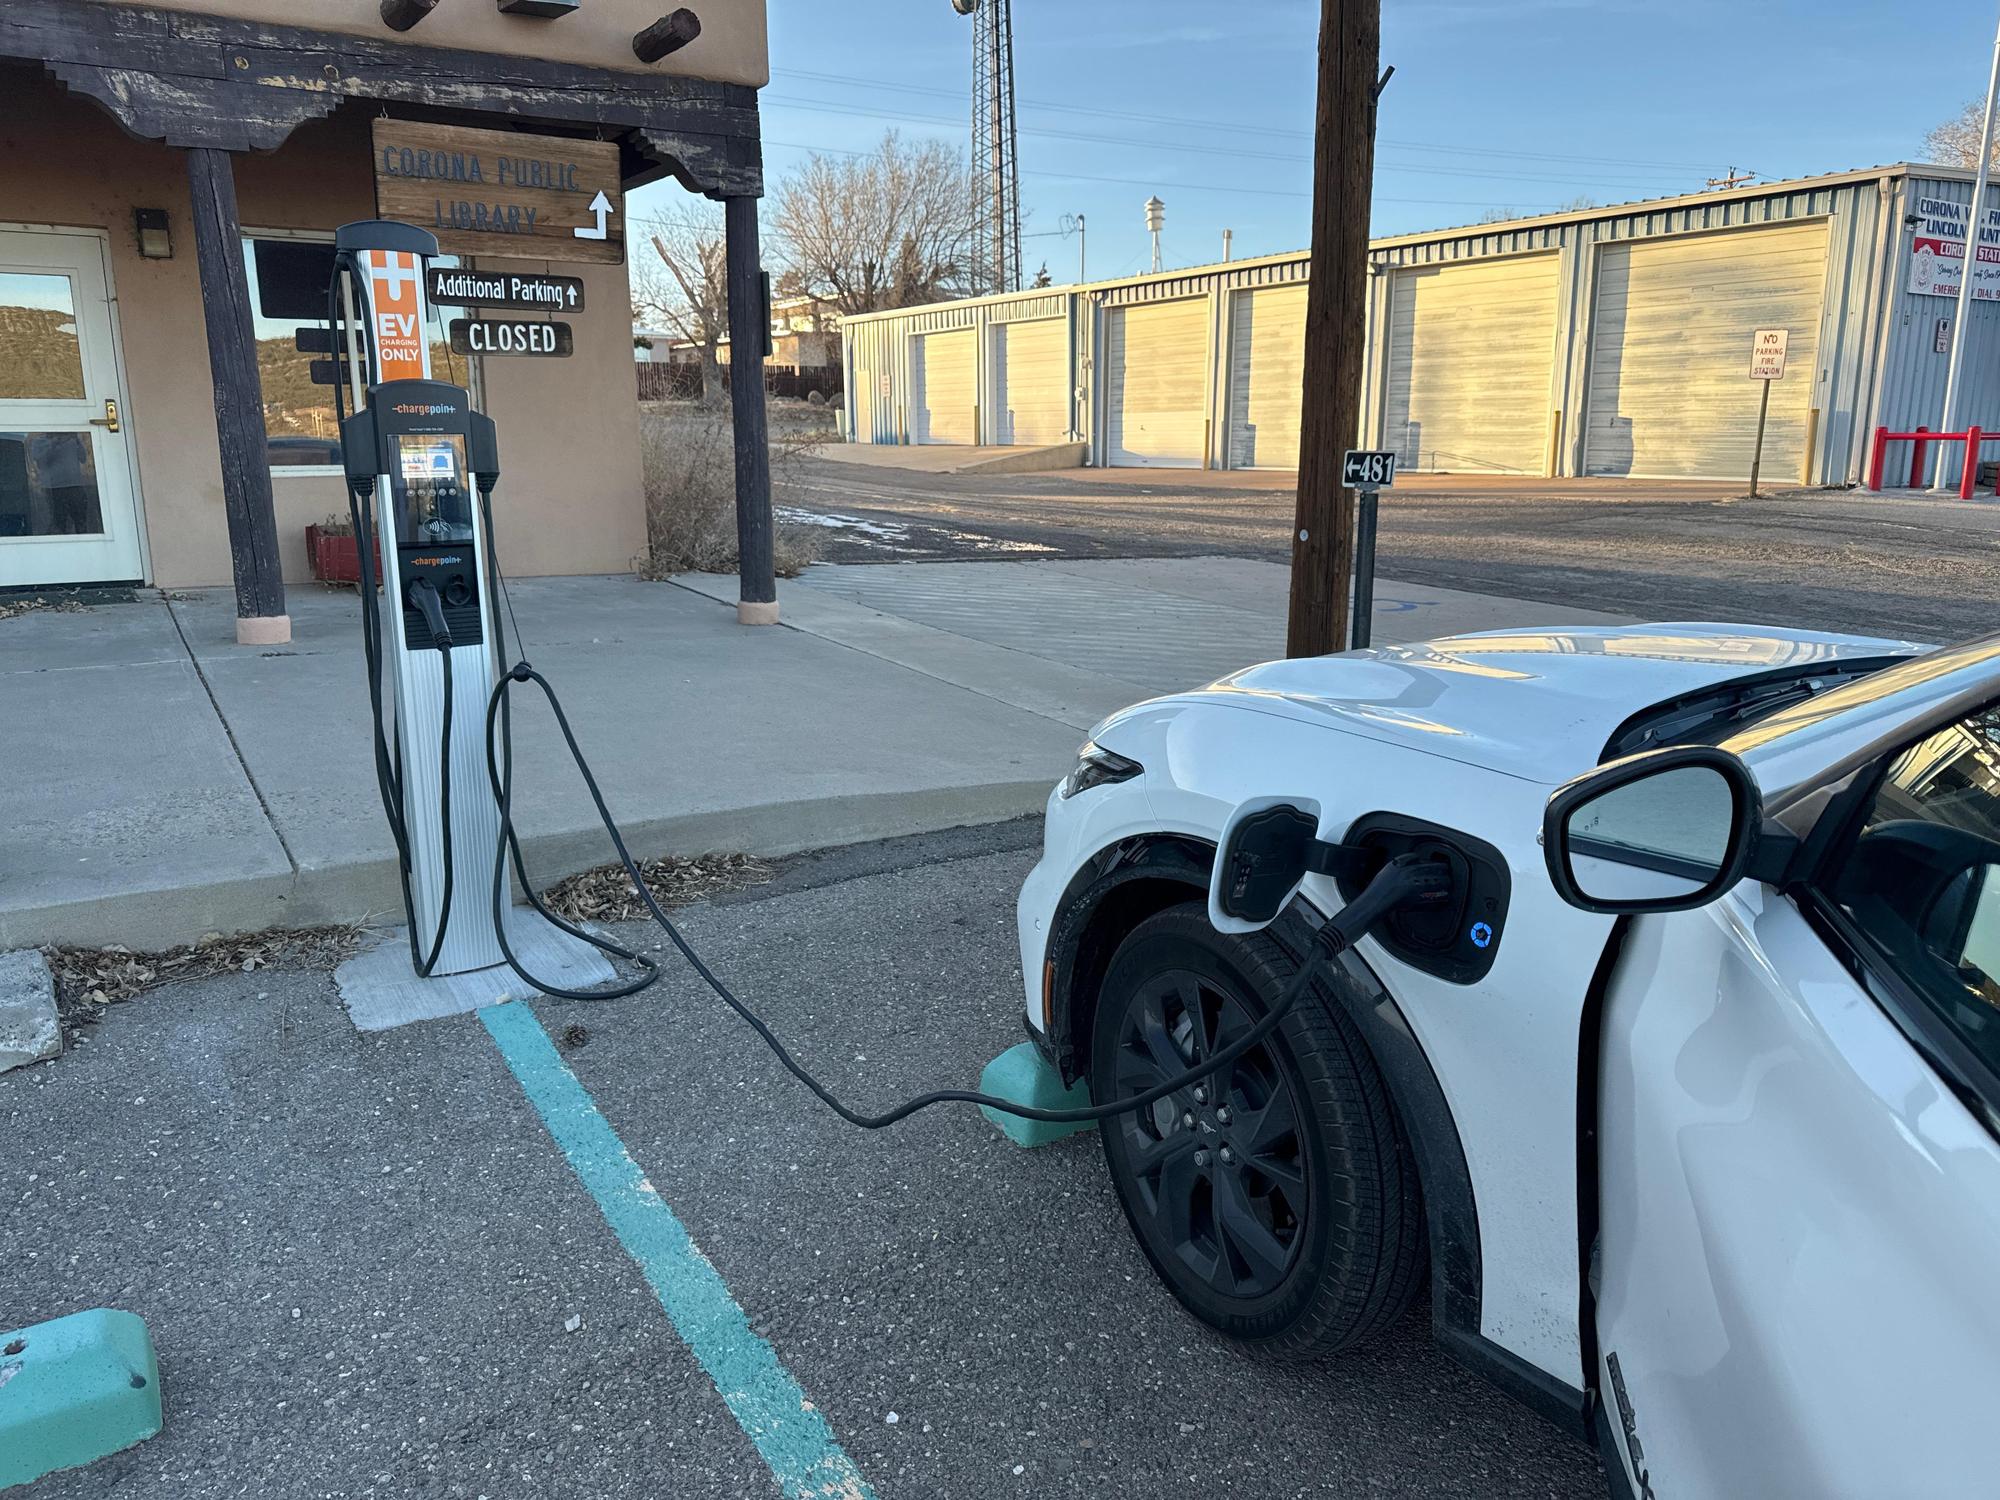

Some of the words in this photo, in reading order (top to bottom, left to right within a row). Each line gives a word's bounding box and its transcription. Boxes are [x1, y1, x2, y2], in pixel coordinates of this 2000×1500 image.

[384, 145, 483, 183] CORONA
[498, 156, 580, 192] PUBLIC
[435, 199, 537, 234] LIBRARY
[1920, 198, 1960, 220] CORONA
[1926, 218, 1967, 239] LINCOLN
[1940, 242, 1965, 258] CORO
[436, 273, 505, 299] Additional
[511, 278, 564, 309] Parking
[1977, 288, 1992, 299] DIAL
[378, 313, 416, 337] EV
[380, 338, 418, 346] CHARGING
[469, 322, 556, 353] CLOSED
[1763, 334, 1778, 344] NO
[381, 348, 419, 361] ONLY
[1755, 347, 1783, 356] PARKING
[1761, 357, 1775, 365] FIRE
[1754, 367, 1780, 375] STATION
[1360, 455, 1394, 482] 481
